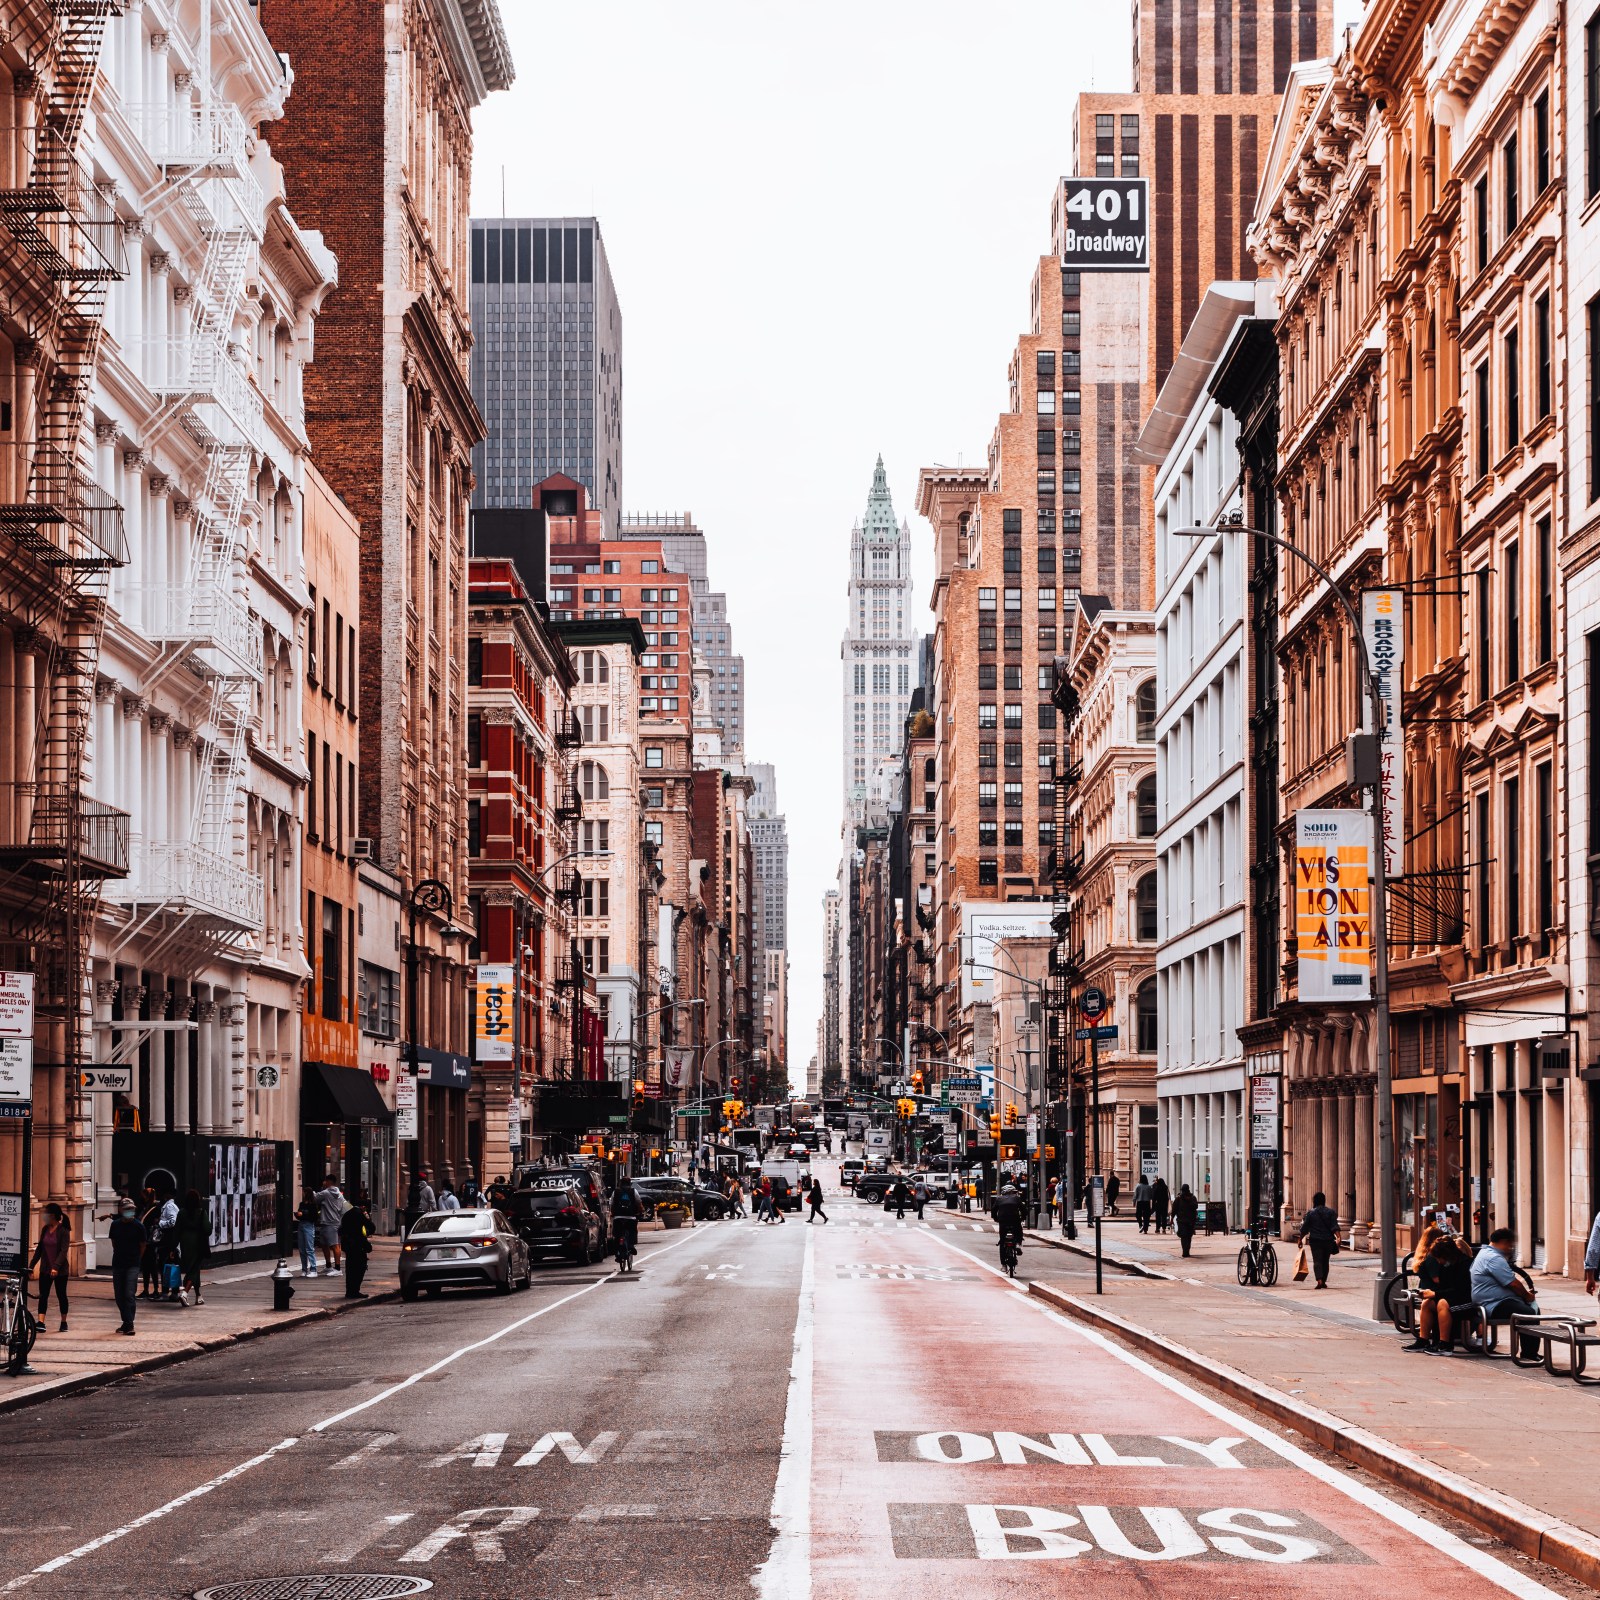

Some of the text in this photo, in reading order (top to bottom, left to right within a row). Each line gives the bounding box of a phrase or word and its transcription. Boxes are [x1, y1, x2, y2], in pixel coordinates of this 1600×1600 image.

[1066, 188, 1139, 221] 401
[1066, 229, 1145, 259] Broadway
[1371, 619, 1396, 672] BROADWAY
[1304, 823, 1337, 832] SOHO
[1299, 856, 1340, 884] VIS
[1308, 888, 1359, 916] ION
[1313, 921, 1368, 948] ARY
[485, 987, 509, 1036] tech
[97, 1073, 127, 1087] Valley
[530, 1178, 581, 1189] KABACK
[912, 1430, 1252, 1469] ONLY
[964, 1503, 1333, 1563] BUS
